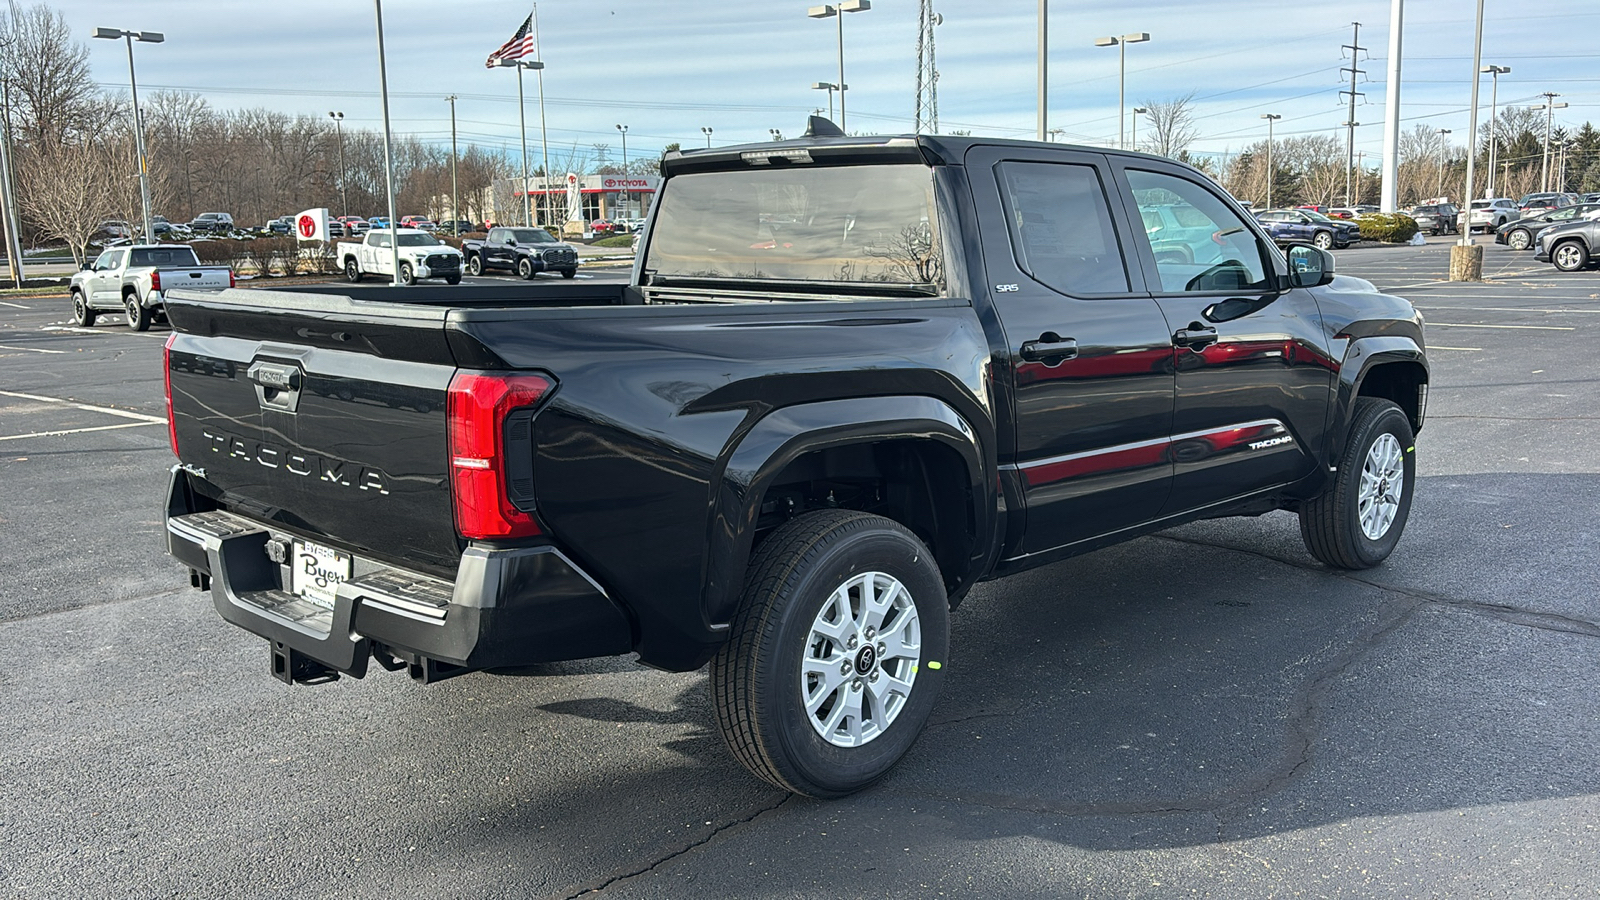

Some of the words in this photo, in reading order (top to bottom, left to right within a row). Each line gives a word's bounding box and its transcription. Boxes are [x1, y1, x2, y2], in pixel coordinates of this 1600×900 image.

[617, 179, 648, 187] TOYOTA
[995, 283, 1020, 293] SR5
[1248, 435, 1293, 450] TACOMA
[203, 431, 390, 495] TACOMA
